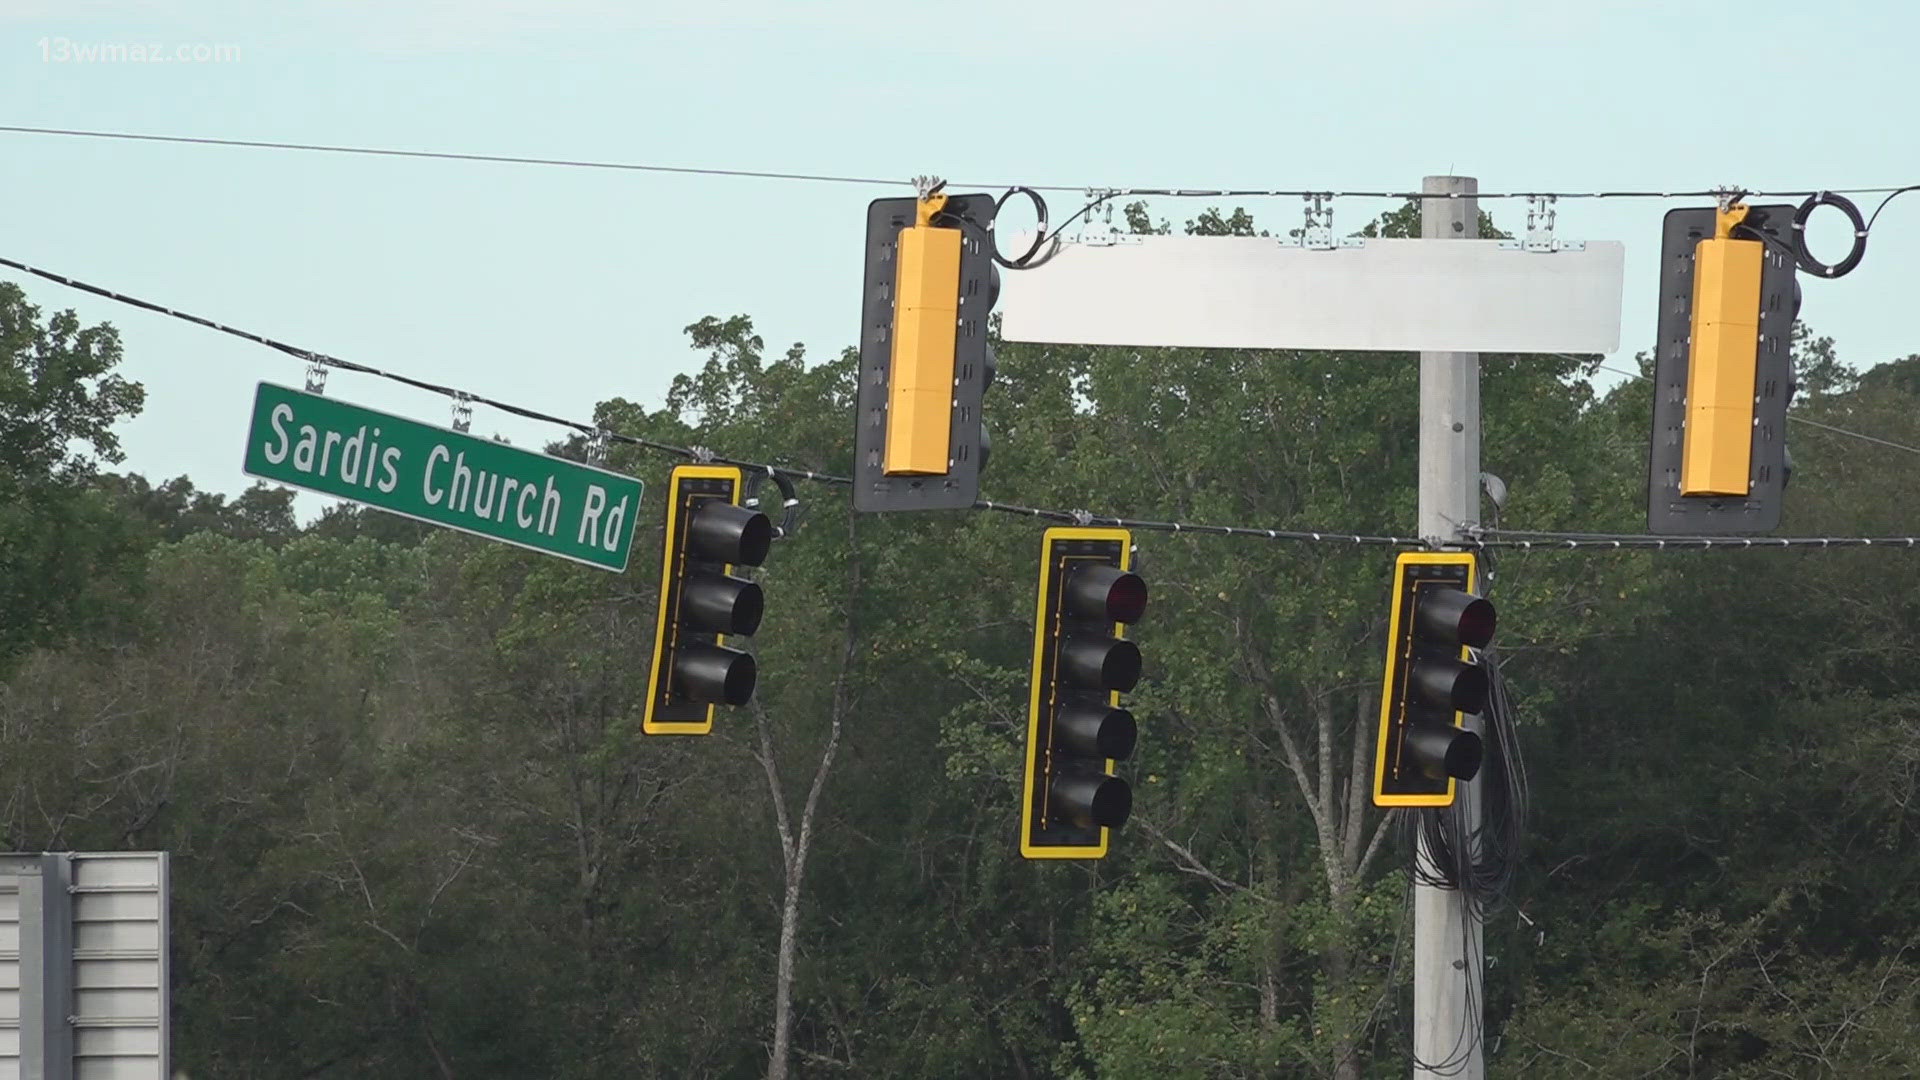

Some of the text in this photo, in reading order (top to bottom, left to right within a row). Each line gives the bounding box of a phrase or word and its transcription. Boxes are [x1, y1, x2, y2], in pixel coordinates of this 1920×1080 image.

[264, 403, 629, 553] Sardis Church Rd
